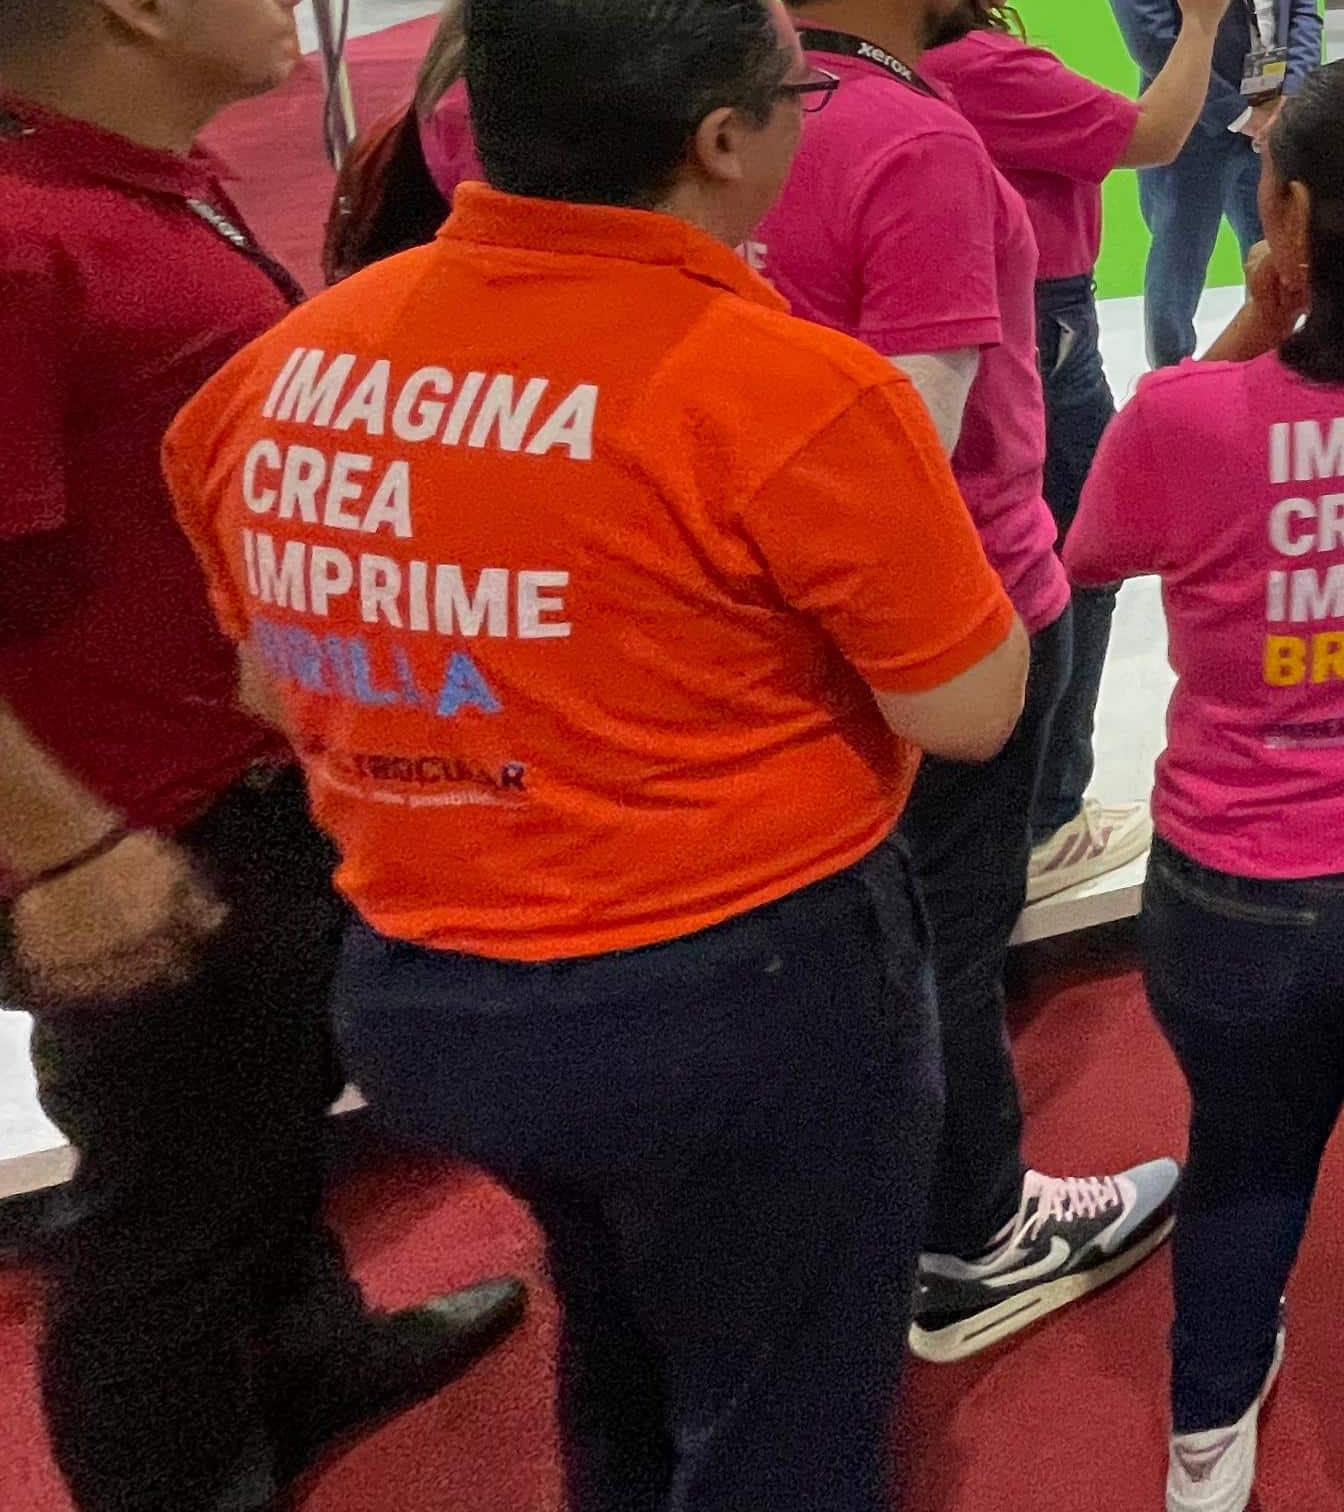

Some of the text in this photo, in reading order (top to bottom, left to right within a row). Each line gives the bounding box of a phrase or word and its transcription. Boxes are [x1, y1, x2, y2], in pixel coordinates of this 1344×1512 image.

[857, 42, 912, 81] xerox
[262, 346, 599, 461] IMAGINA
[242, 438, 413, 538] CREA
[242, 530, 572, 640] IMPRIME
